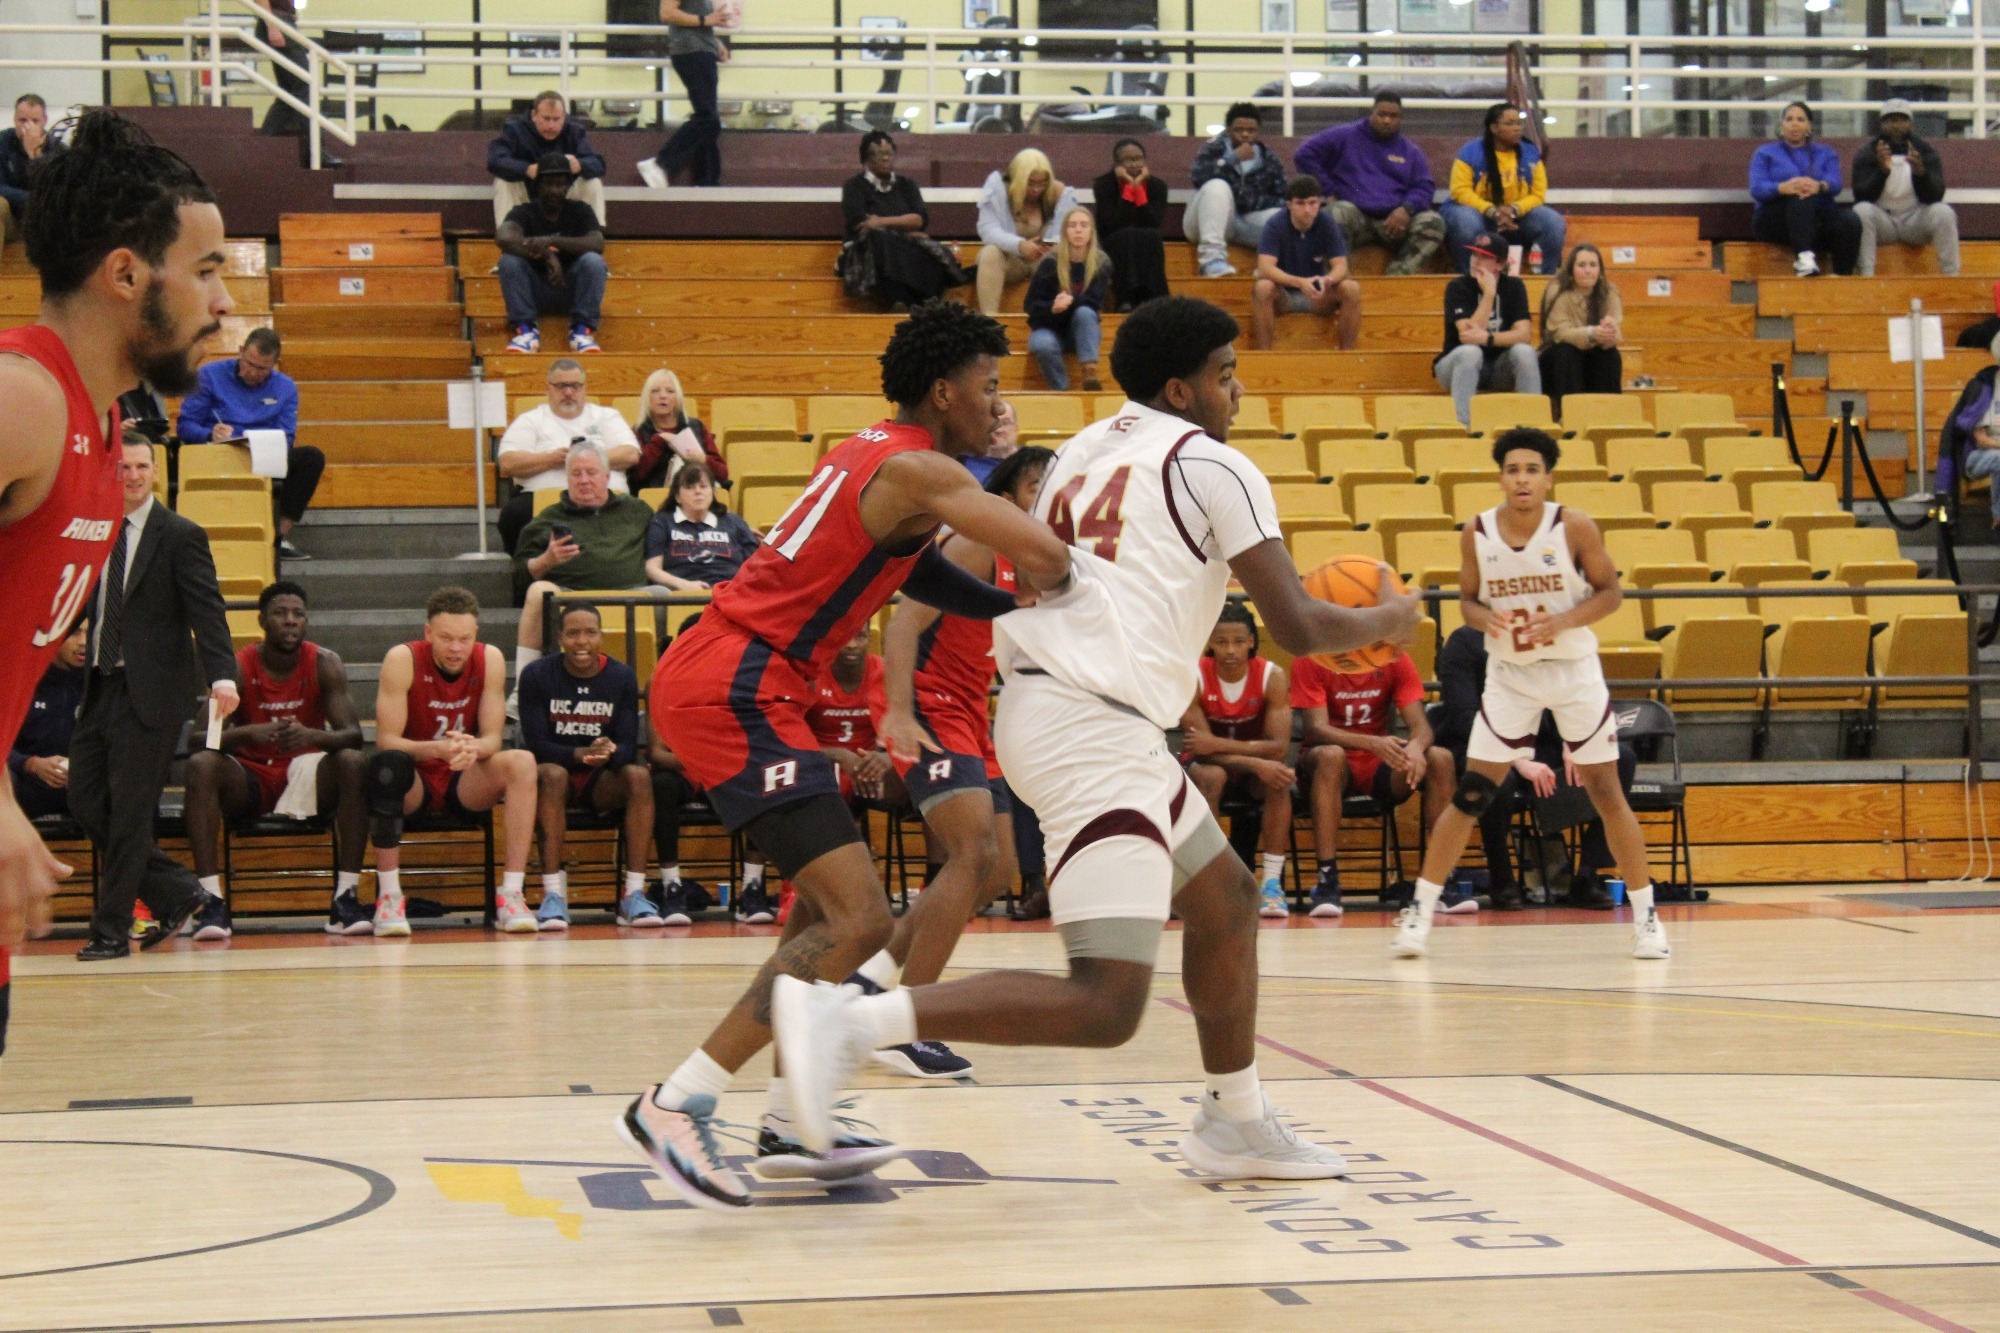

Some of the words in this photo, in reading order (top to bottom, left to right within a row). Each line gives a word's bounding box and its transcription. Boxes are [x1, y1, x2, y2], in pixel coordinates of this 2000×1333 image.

[762, 464, 849, 562] 21
[1047, 464, 1134, 563] 44
[60, 517, 114, 542] AIKEN
[1487, 574, 1564, 598] ERSKINE
[550, 699, 571, 714] USC
[573, 701, 614, 717] AIKEN
[1344, 704, 1371, 727] 12
[433, 713, 466, 740] 24
[556, 721, 602, 737] PACERS
[838, 721, 853, 742] 3
[763, 759, 797, 795] A
